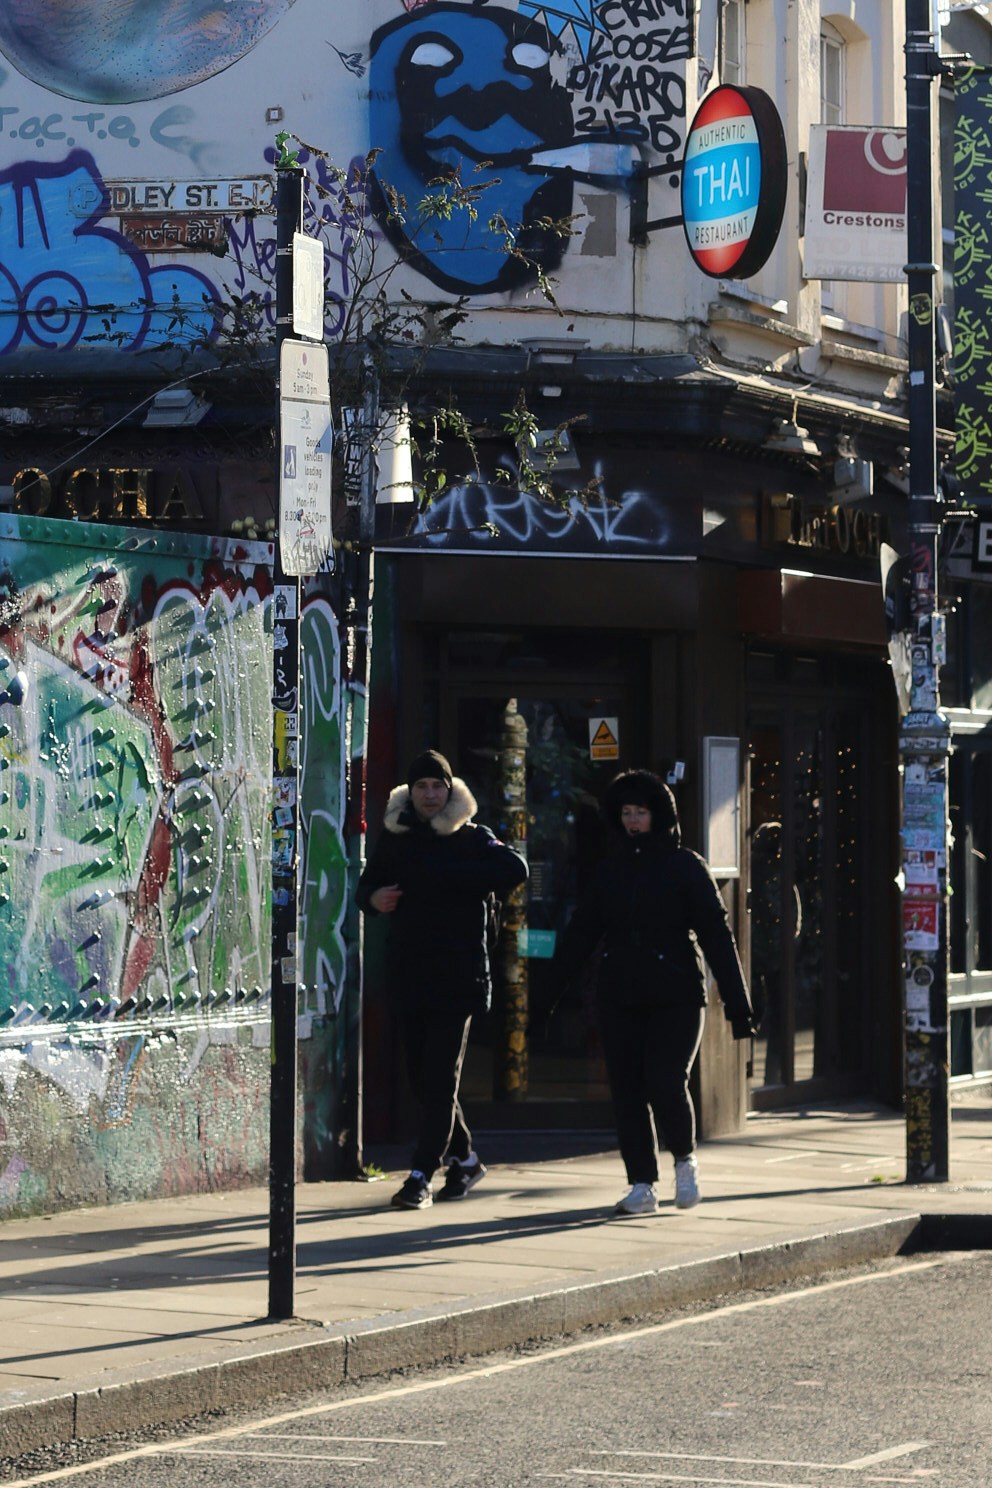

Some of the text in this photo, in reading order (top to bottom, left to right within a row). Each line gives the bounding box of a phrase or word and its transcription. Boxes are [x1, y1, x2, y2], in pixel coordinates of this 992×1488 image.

[698, 123, 747, 150] AUTHENTIC
[694, 155, 751, 208] THAI
[694, 215, 750, 244] RESTAURANT
[823, 212, 905, 229] Crestons
[304, 451, 323, 462] vehicles
[304, 465, 322, 479] loading
[11, 467, 205, 520] OCHA
